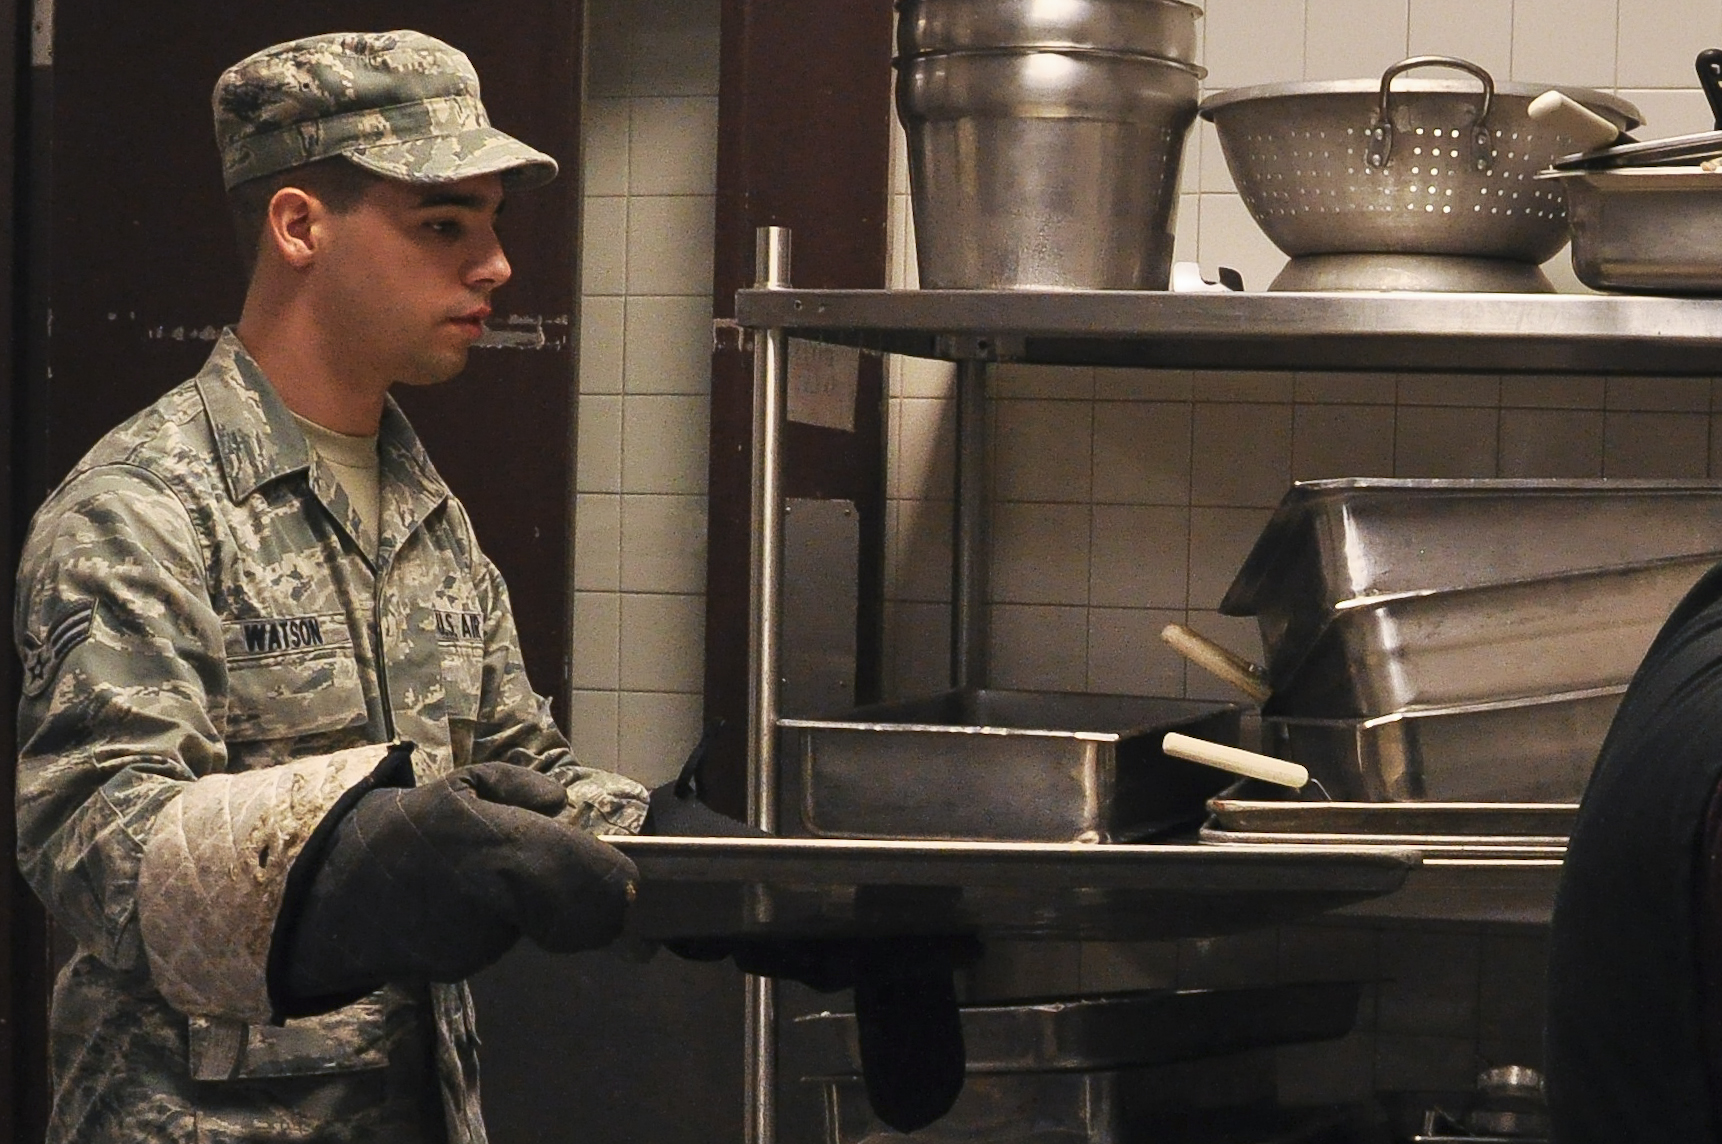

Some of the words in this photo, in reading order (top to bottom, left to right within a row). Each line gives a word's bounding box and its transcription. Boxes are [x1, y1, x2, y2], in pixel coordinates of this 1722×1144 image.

[243, 618, 323, 652] WATSON
[435, 611, 458, 638] U.S.
[461, 613, 481, 638] AIR
